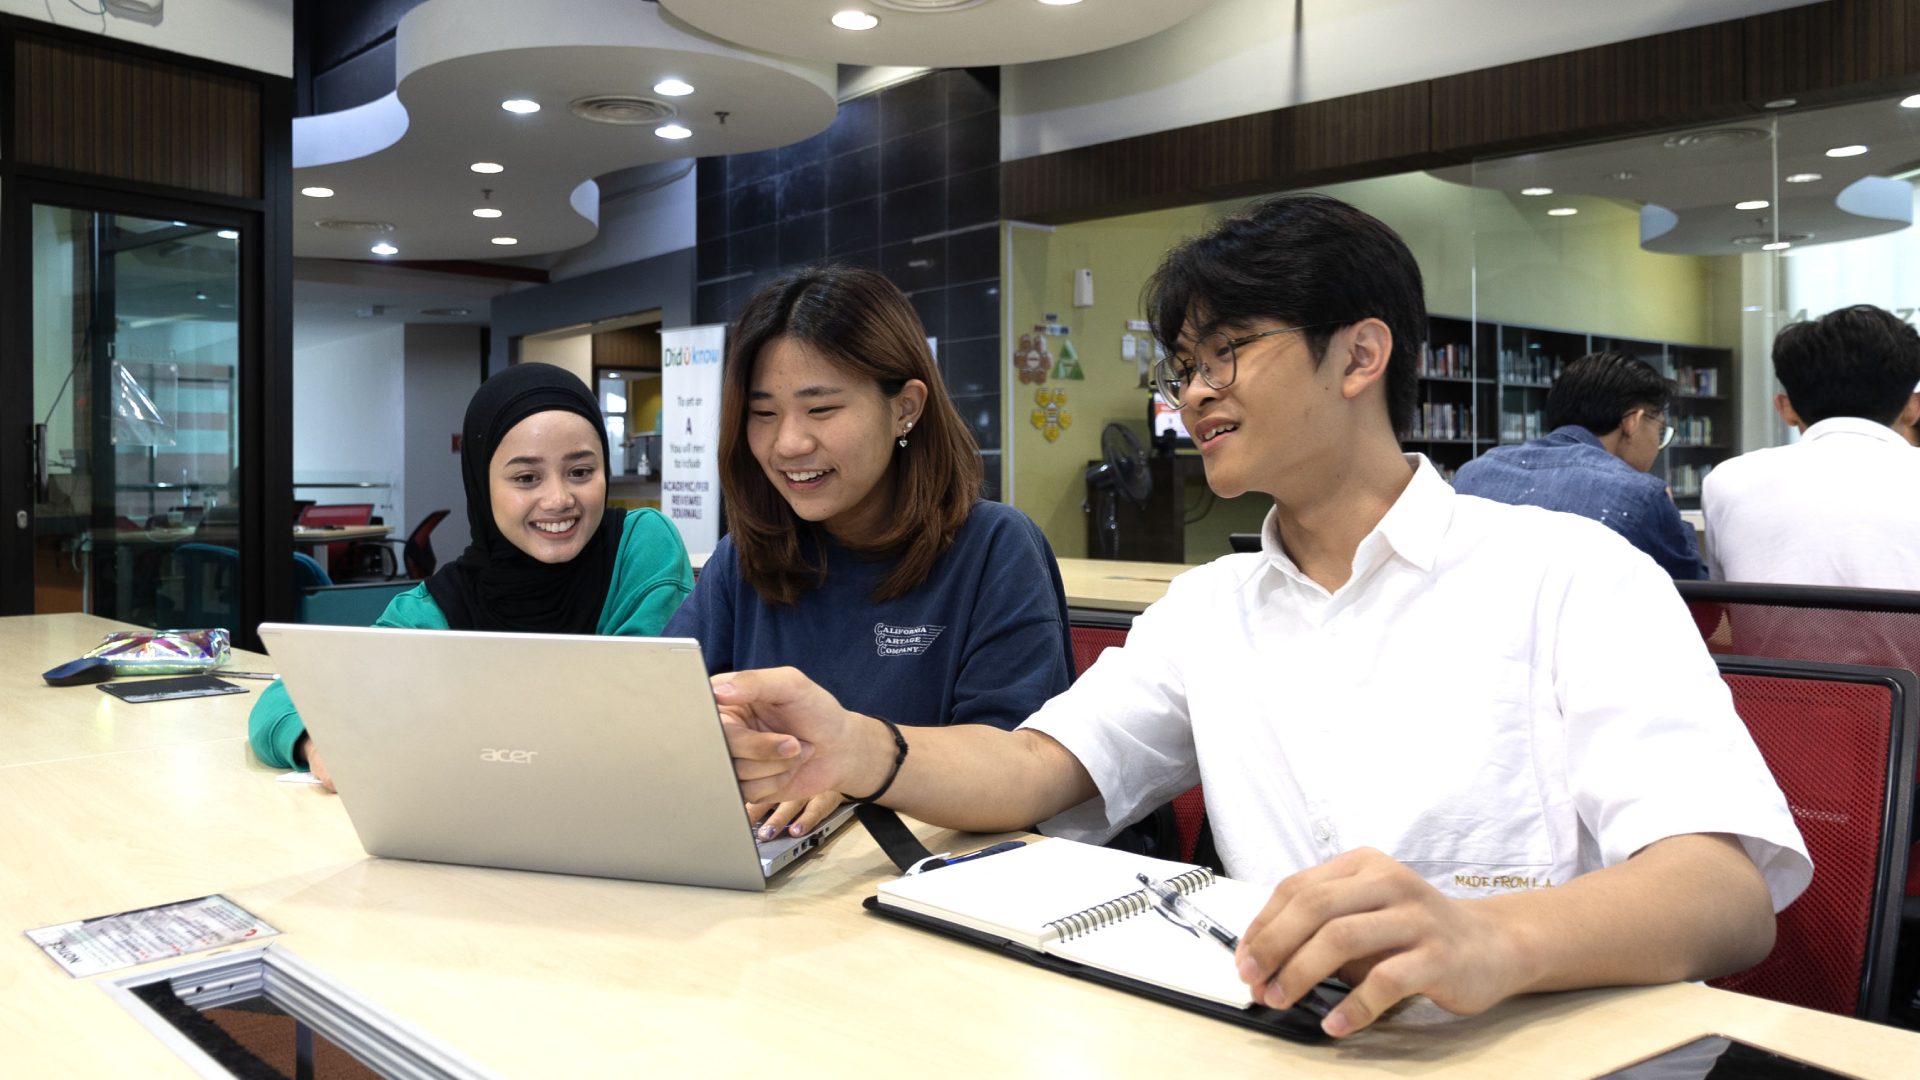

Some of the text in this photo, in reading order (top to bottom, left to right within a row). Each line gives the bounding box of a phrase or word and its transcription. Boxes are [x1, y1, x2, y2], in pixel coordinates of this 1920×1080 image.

[664, 347, 682, 368] Did
[692, 346, 719, 366] know
[685, 417, 692, 435] A
[874, 622, 927, 635] CALIFORNIA
[876, 634, 921, 646] CARTAGE
[877, 645, 920, 656] COMPANY
[480, 747, 539, 764] acer
[1455, 875, 1489, 888] MADE
[1493, 875, 1529, 889] FROM
